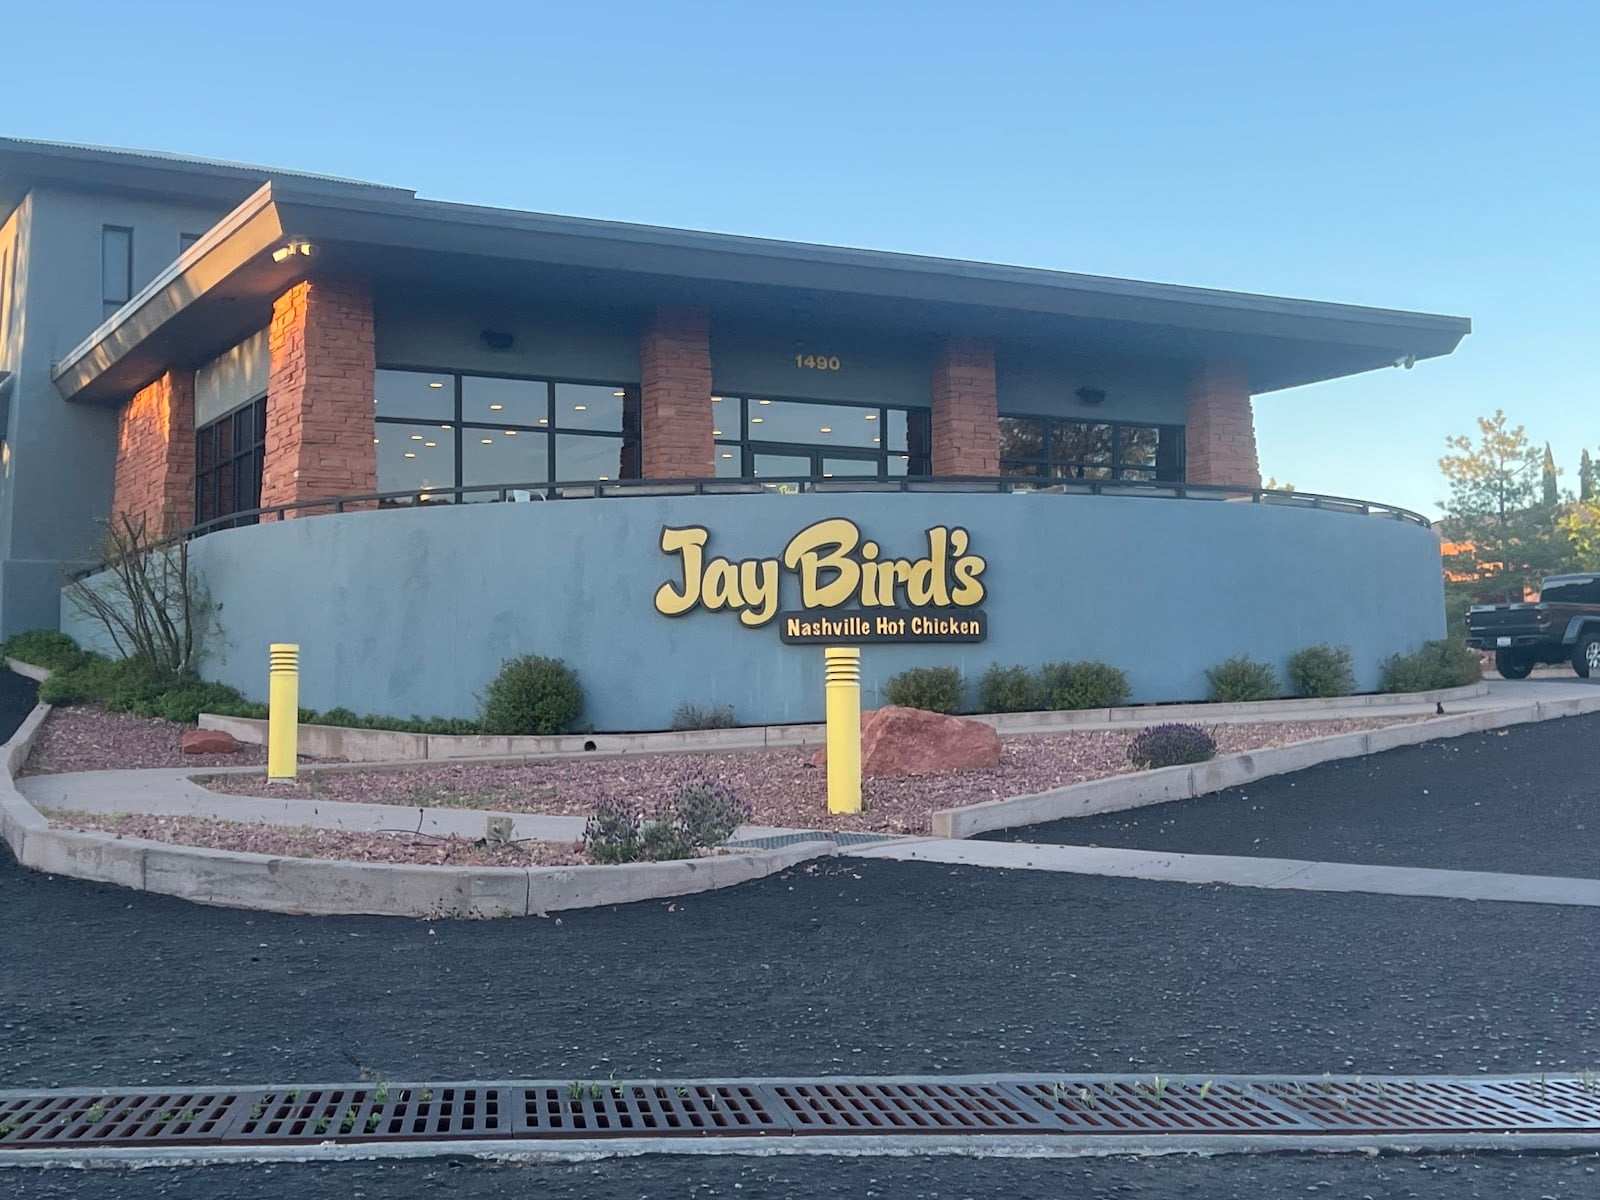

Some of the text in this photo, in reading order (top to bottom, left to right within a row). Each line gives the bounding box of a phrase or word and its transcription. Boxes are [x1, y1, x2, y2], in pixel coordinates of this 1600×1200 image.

[795, 354, 840, 370] 1490
[653, 518, 986, 626] Jay Bird's
[787, 617, 980, 636] Nashville Hot Chicken
